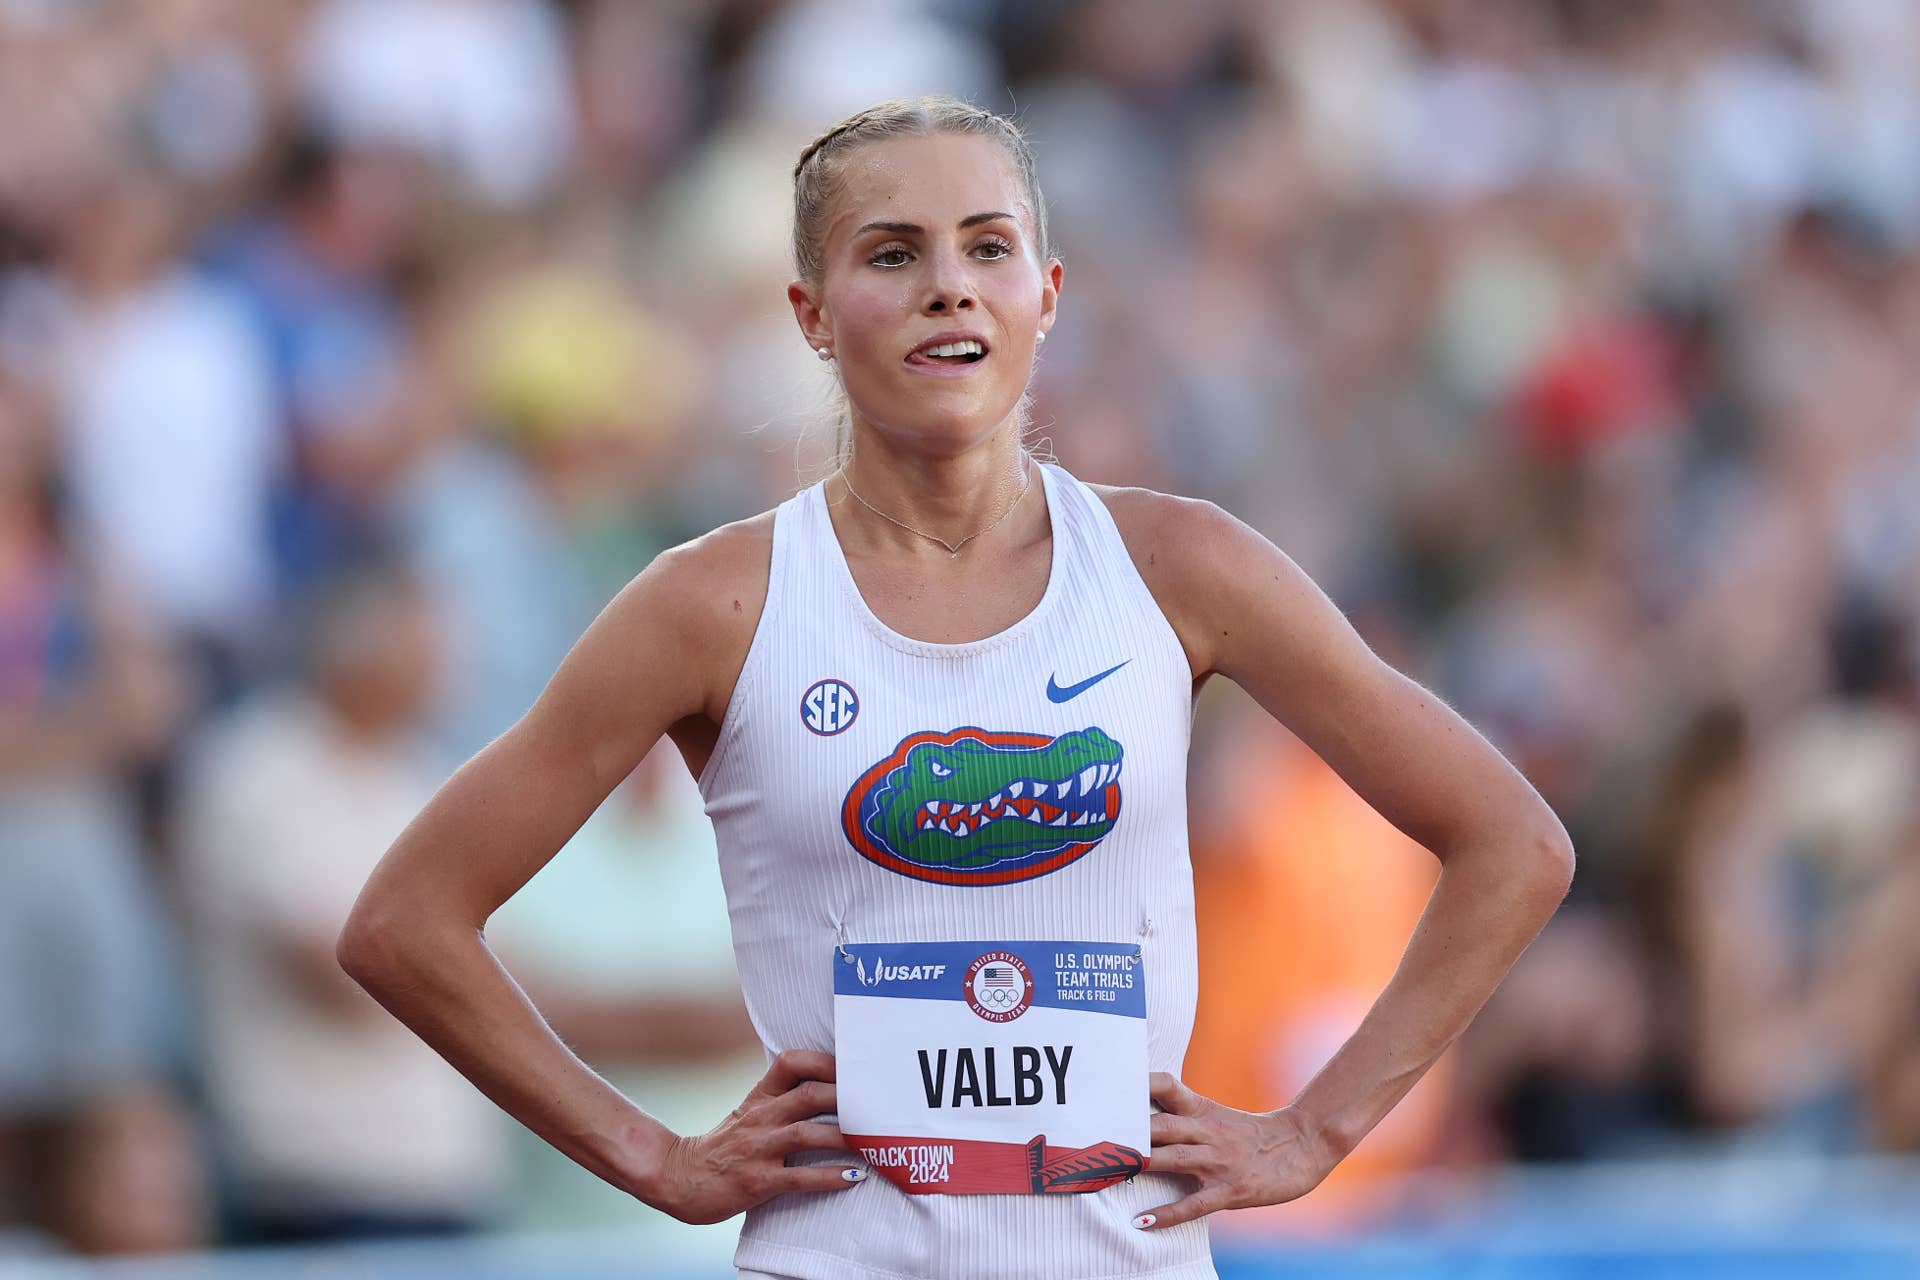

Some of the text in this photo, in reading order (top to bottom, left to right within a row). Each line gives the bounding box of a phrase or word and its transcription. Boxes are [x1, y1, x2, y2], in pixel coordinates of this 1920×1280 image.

[805, 683, 855, 732] SEC
[971, 953, 1027, 972] UNITED STATES
[1055, 953, 1133, 971] U.S. OLYMPIC
[883, 965, 946, 981] USATF
[1055, 971, 1133, 989] TEAM TRIALS
[1056, 989, 1116, 1002] TRACK & FIELD
[972, 1003, 1027, 1021] OLYMPIC TEAM
[917, 1045, 1074, 1109] VALBY
[859, 1145, 954, 1167] TRACKTOWN
[909, 1163, 950, 1184] 2024
